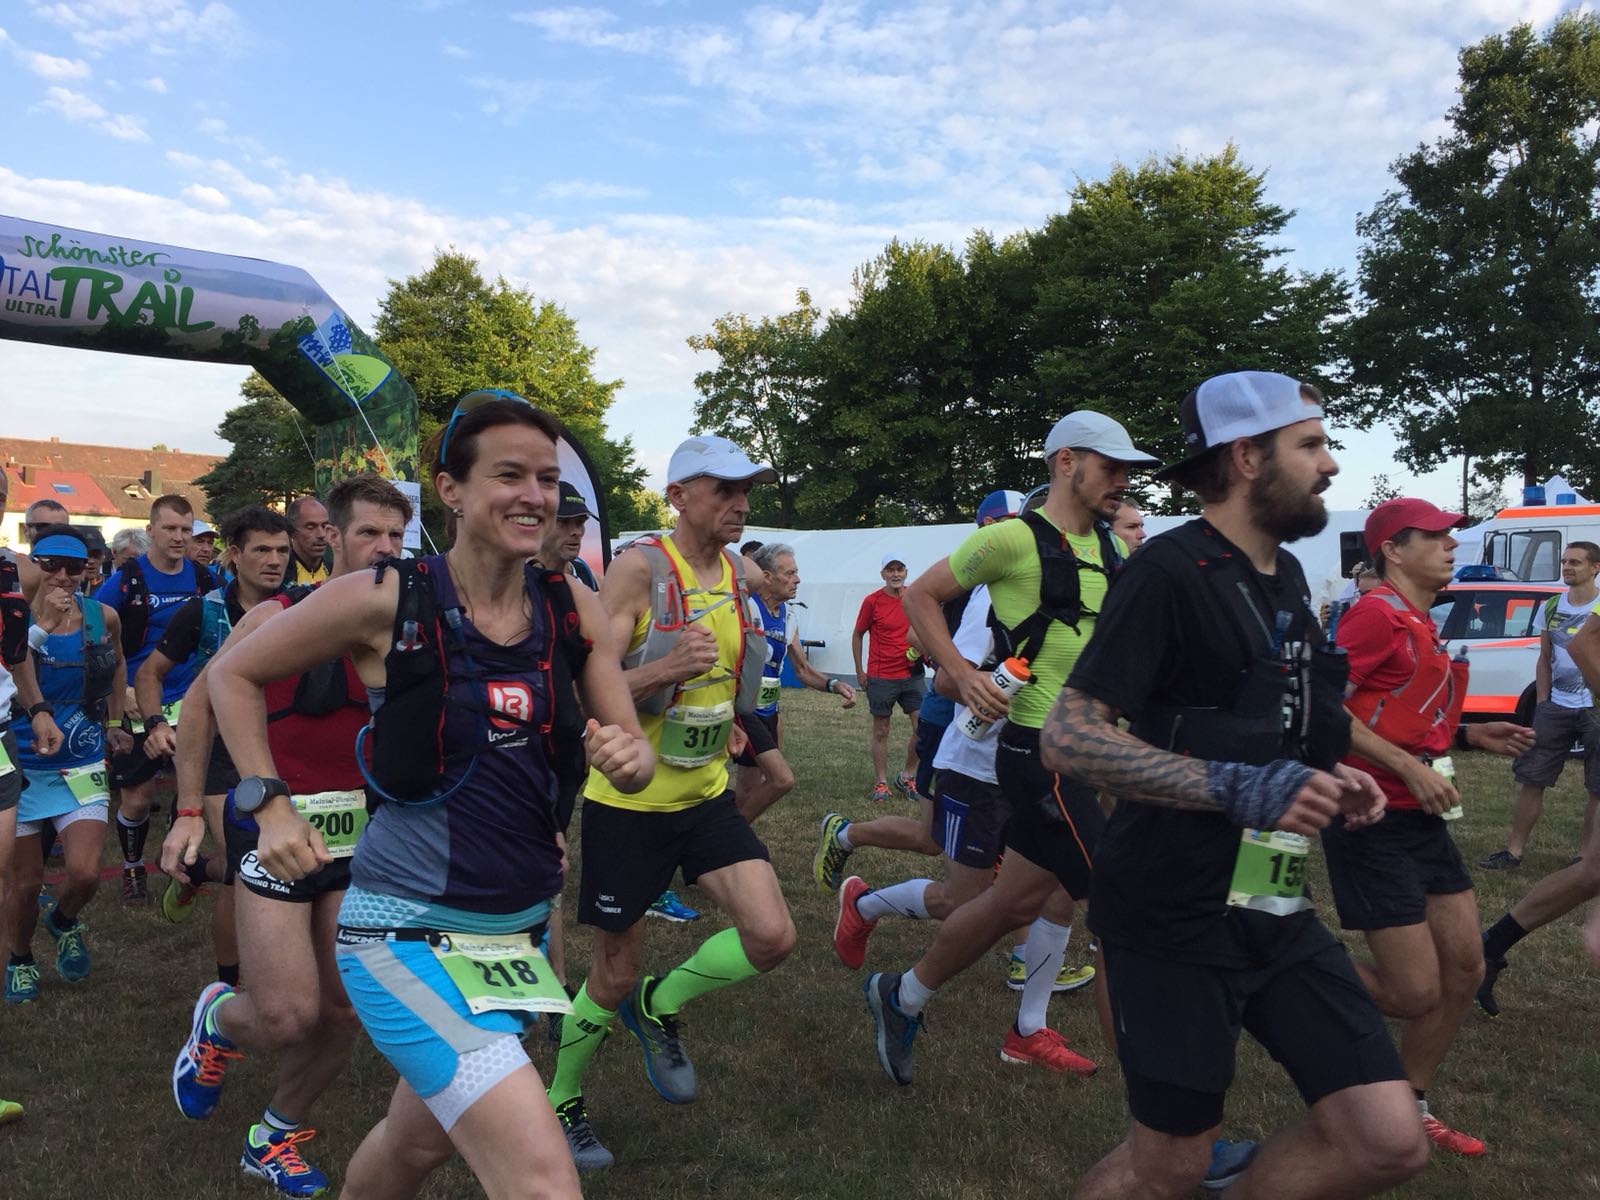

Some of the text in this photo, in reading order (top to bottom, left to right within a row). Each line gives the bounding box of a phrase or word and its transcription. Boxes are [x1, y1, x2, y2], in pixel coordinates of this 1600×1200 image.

[17, 233, 171, 267] schönster
[0, 255, 57, 302] TAL
[5, 299, 57, 318] ULTRA
[683, 724, 722, 749] 317
[309, 811, 354, 837] 200
[270, 882, 290, 895] TEAM
[472, 959, 539, 988] 218
